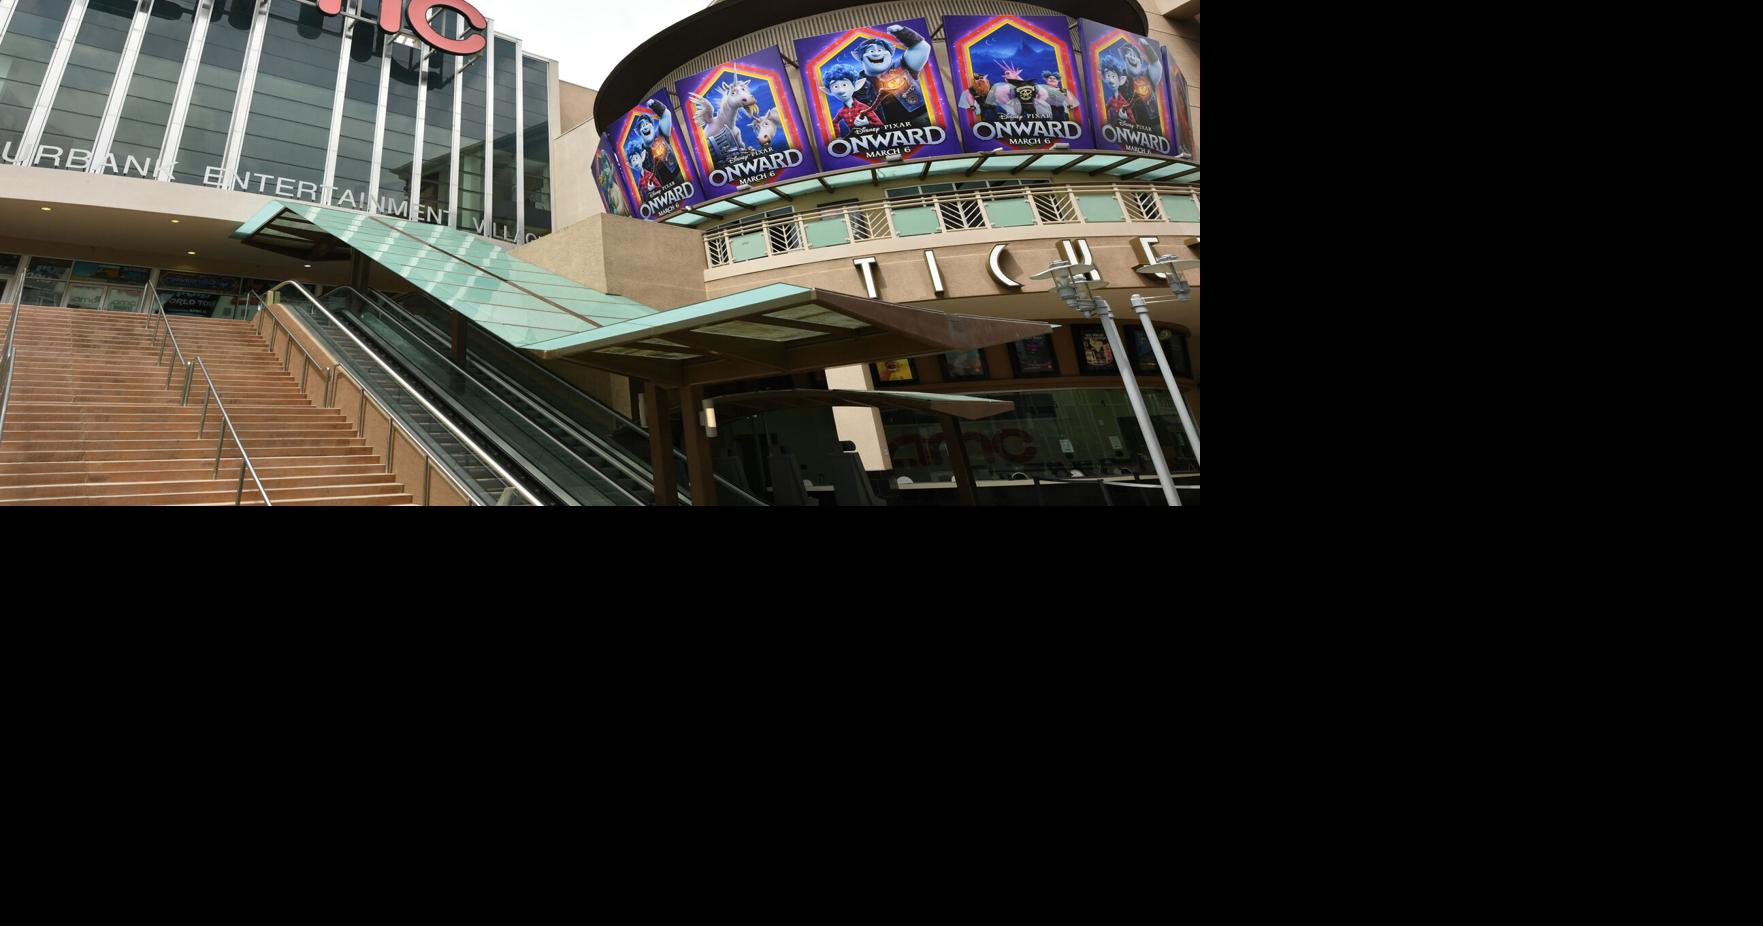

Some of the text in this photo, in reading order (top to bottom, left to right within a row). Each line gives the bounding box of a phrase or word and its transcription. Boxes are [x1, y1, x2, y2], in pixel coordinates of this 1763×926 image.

[852, 121, 912, 135] Disney PIXAR
[973, 121, 1082, 140] ONWARD
[827, 126, 946, 158] ONWARD
[1009, 138, 1041, 146] MARCH
[1102, 124, 1171, 155] ONWARD
[751, 147, 774, 157] PIXAR
[866, 148, 900, 158] MARCH
[1125, 144, 1146, 155] MARCH
[708, 149, 803, 187] ONWARD
[739, 173, 767, 185] MARCH
[640, 181, 694, 219] ONWARD
[658, 205, 674, 217] MARCH
